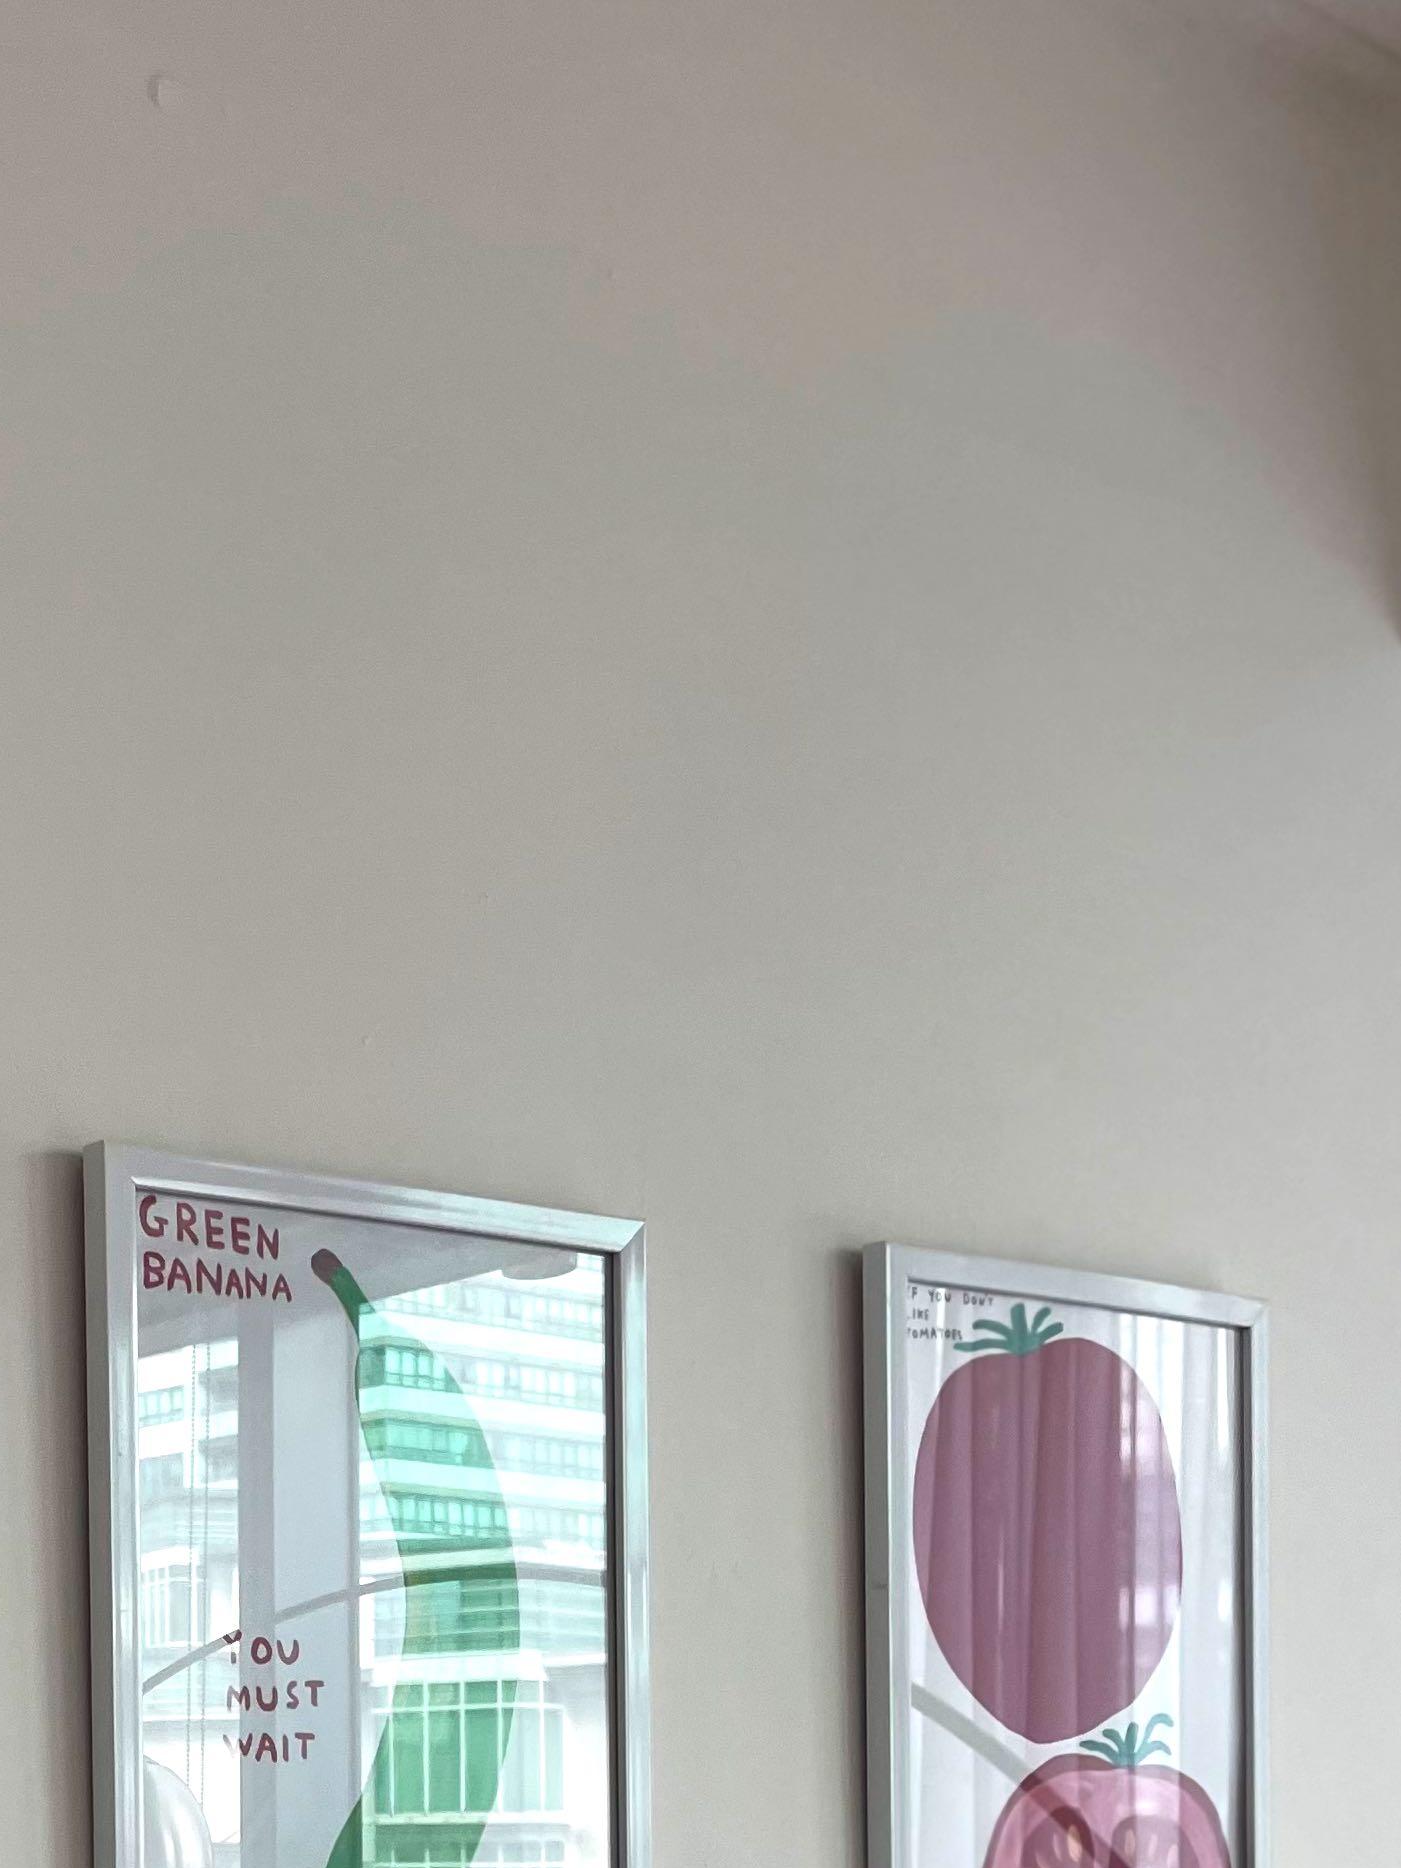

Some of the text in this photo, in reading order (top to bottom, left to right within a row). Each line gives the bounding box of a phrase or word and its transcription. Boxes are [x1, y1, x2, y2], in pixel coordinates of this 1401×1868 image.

[138, 1195, 281, 1260] GREEN
[142, 1251, 293, 1303] BANANA
[222, 1629, 300, 1665] YOU
[227, 1680, 325, 1712] MUST
[222, 1732, 315, 1763] WAIT
